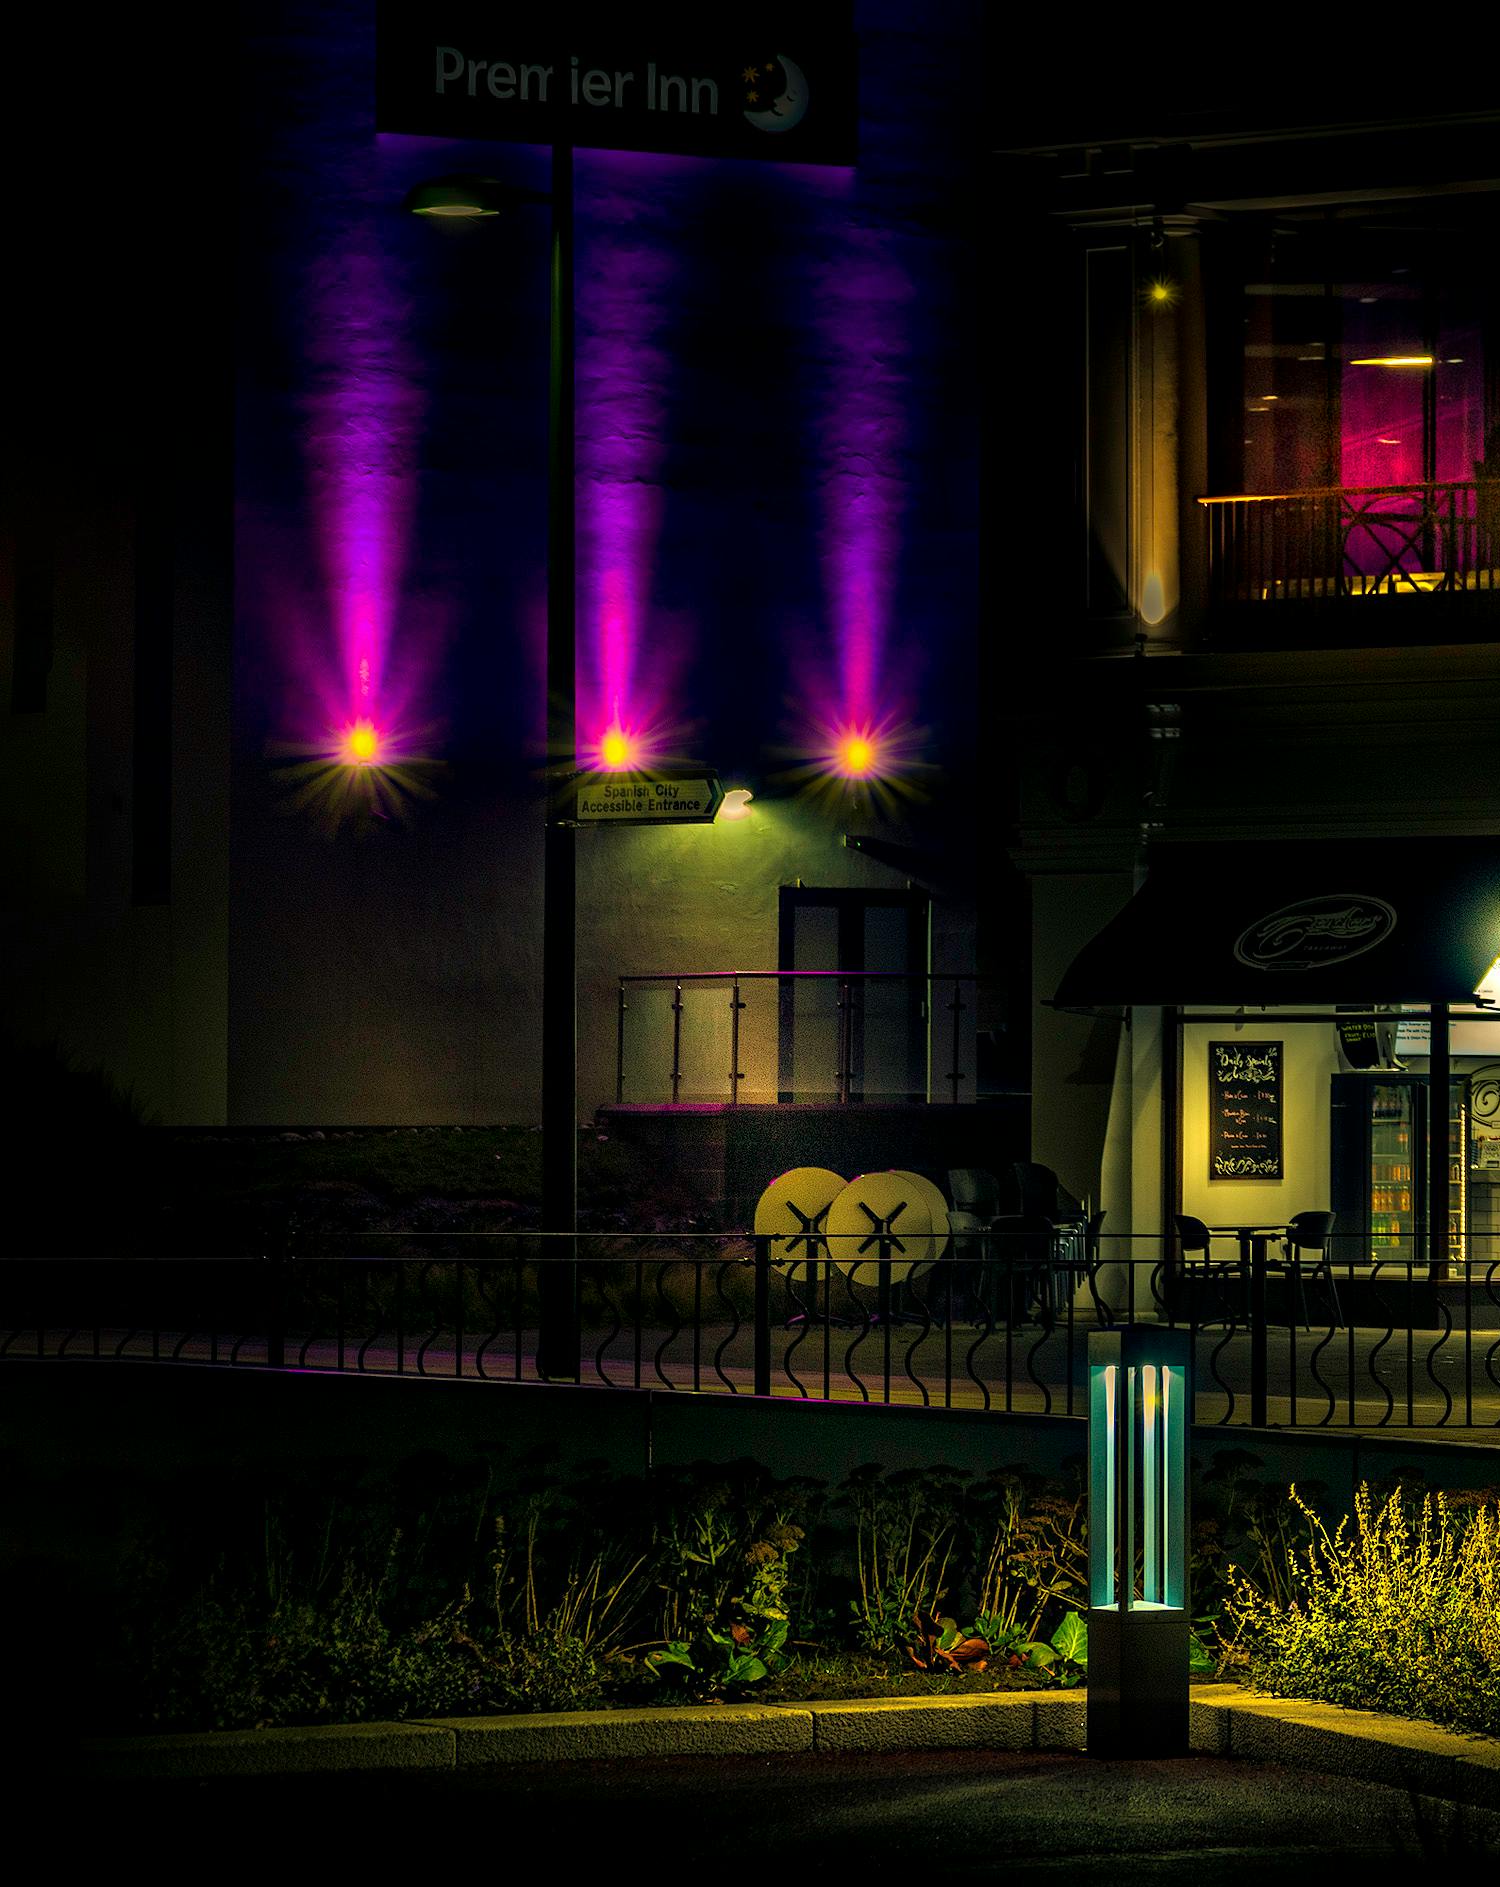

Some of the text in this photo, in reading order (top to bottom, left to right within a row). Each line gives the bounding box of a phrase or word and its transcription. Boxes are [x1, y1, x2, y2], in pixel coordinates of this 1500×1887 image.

[646, 62, 719, 115] Inn
[604, 783, 680, 799] Spanish City
[582, 800, 700, 813] Accessible Entrance
